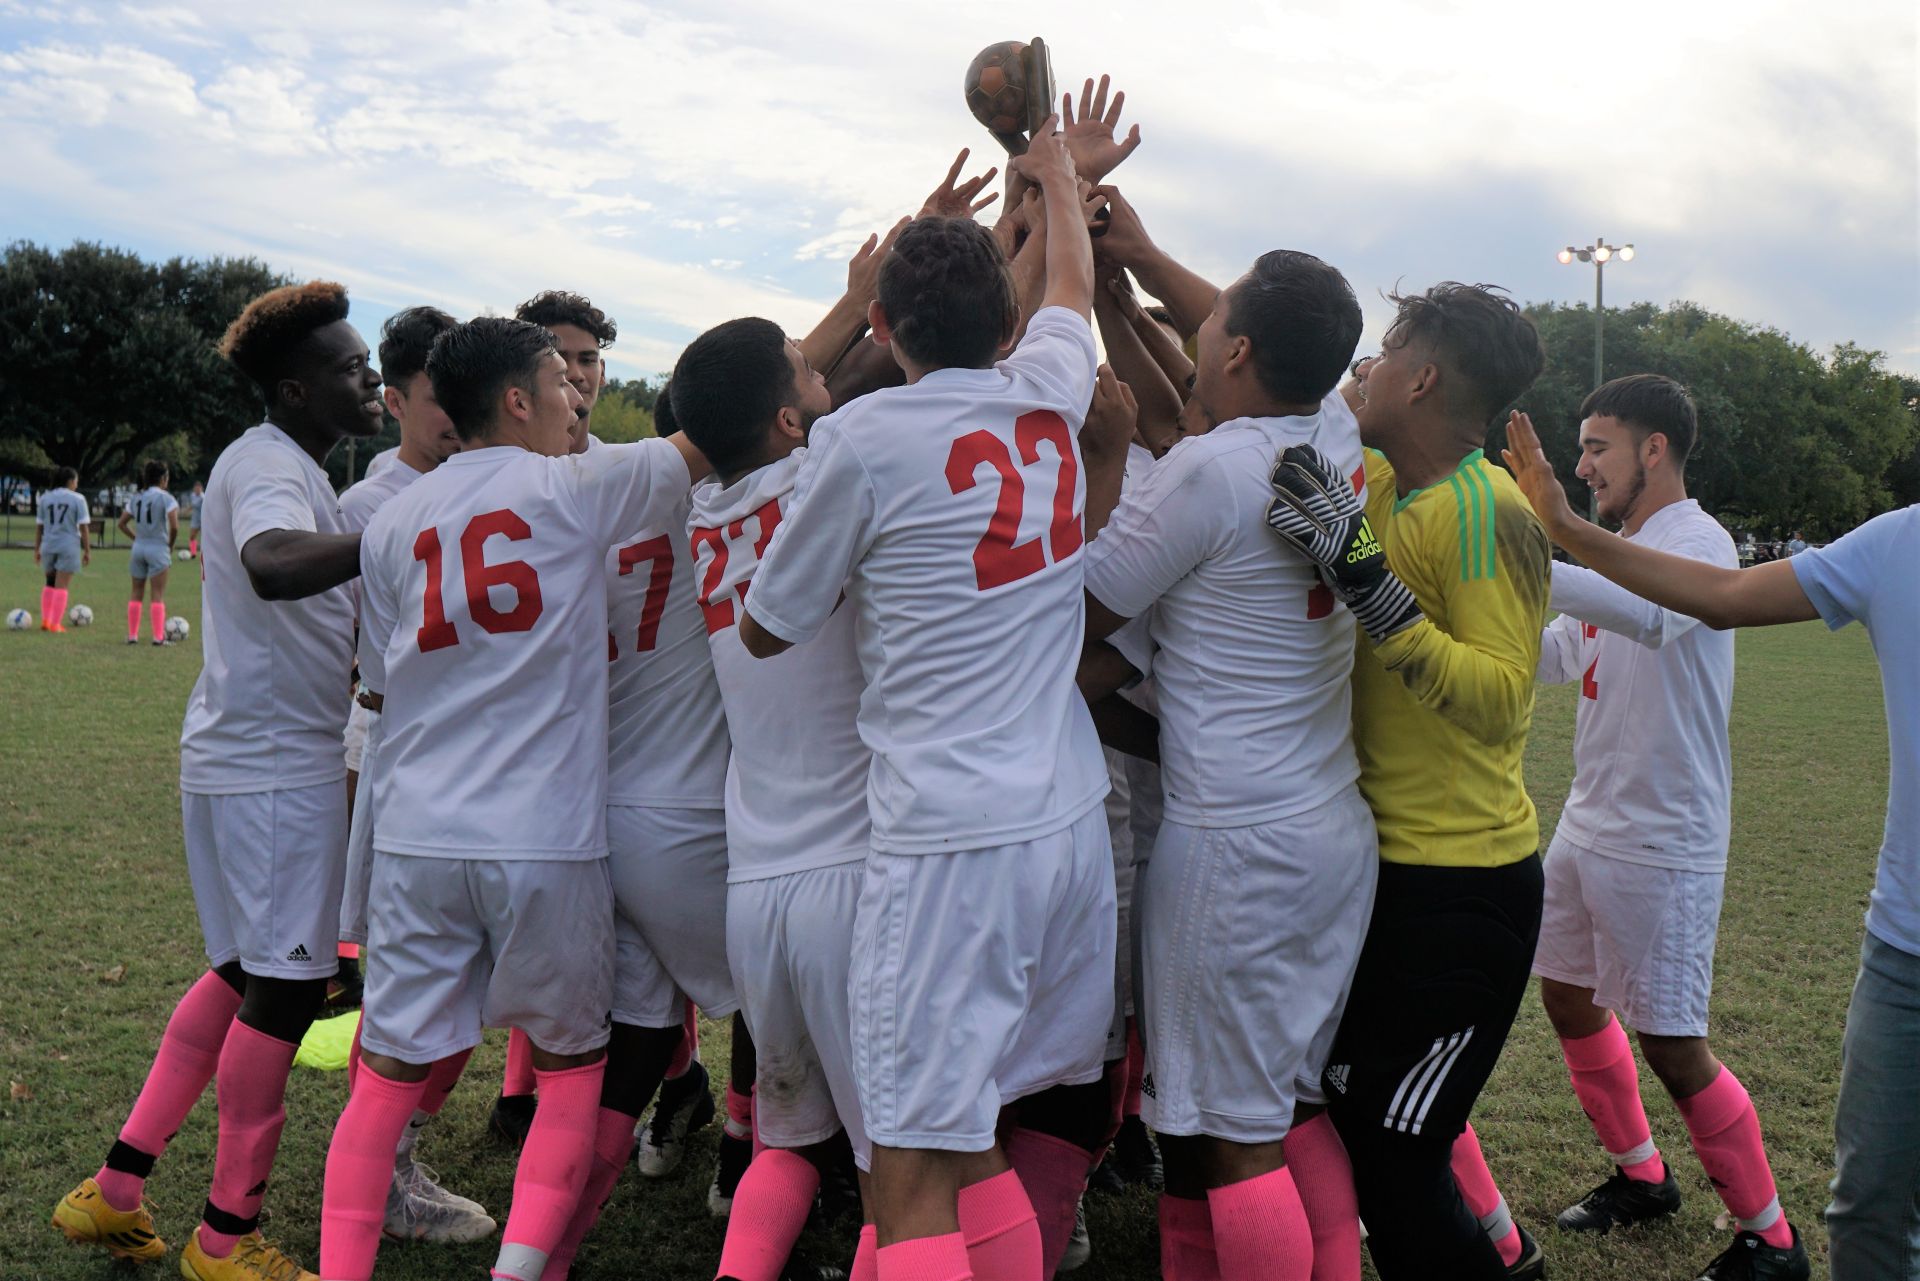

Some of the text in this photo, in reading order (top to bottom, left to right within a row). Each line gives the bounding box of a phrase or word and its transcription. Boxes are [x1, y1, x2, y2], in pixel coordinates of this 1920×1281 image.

[48, 504, 69, 524] 17
[945, 409, 1084, 591] 22
[1346, 540, 1384, 564] adida
[413, 508, 543, 653] 16
[608, 533, 674, 662] 7
